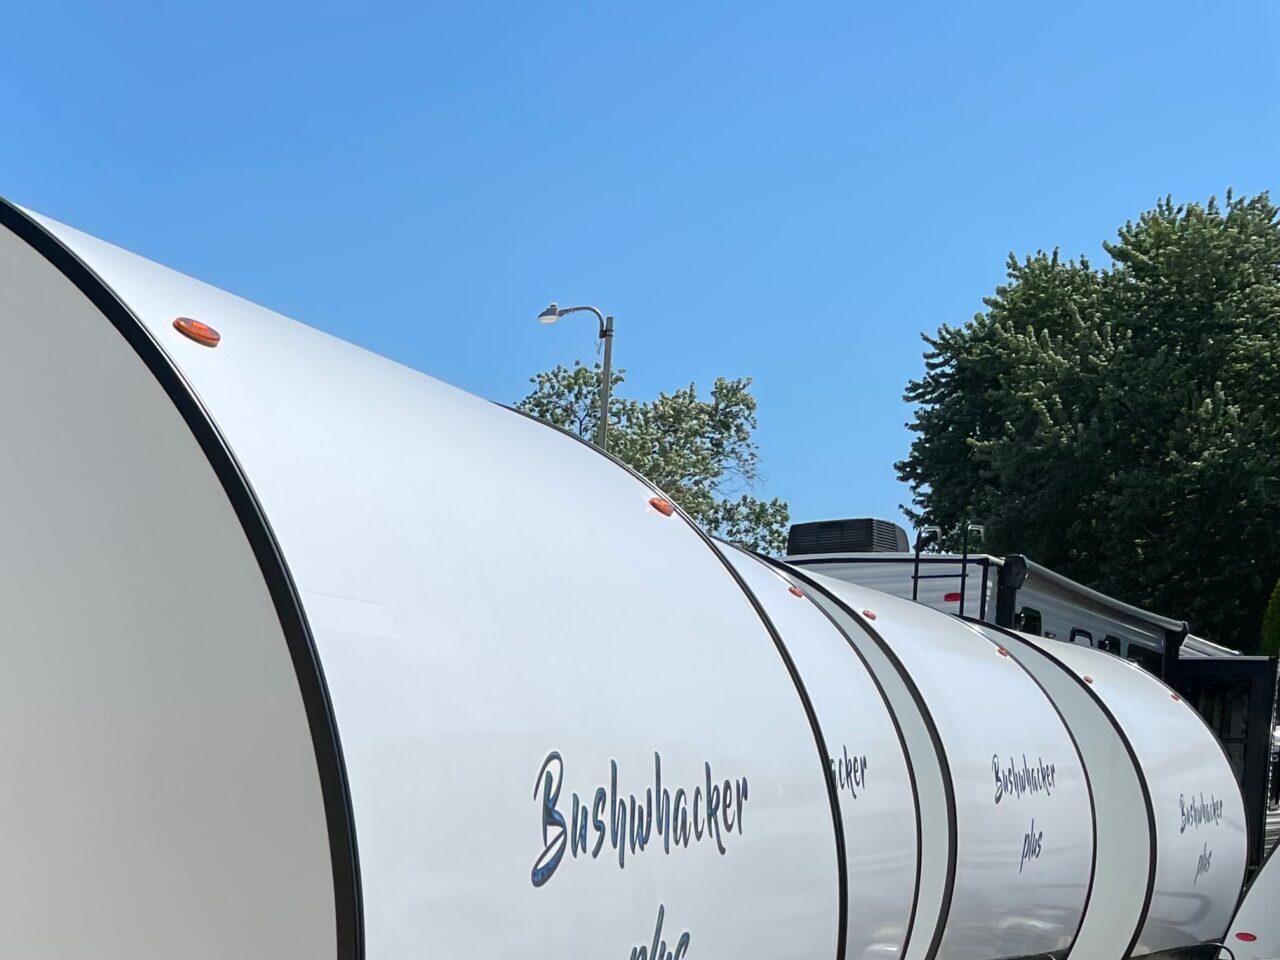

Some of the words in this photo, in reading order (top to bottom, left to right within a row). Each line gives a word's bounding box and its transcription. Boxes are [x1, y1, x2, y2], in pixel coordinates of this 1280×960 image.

[991, 752, 1055, 805] Bushwhacker
[531, 750, 748, 888] Bushwhacker
[1179, 791, 1223, 835] Bushwhacker
[1019, 817, 1043, 874] plus
